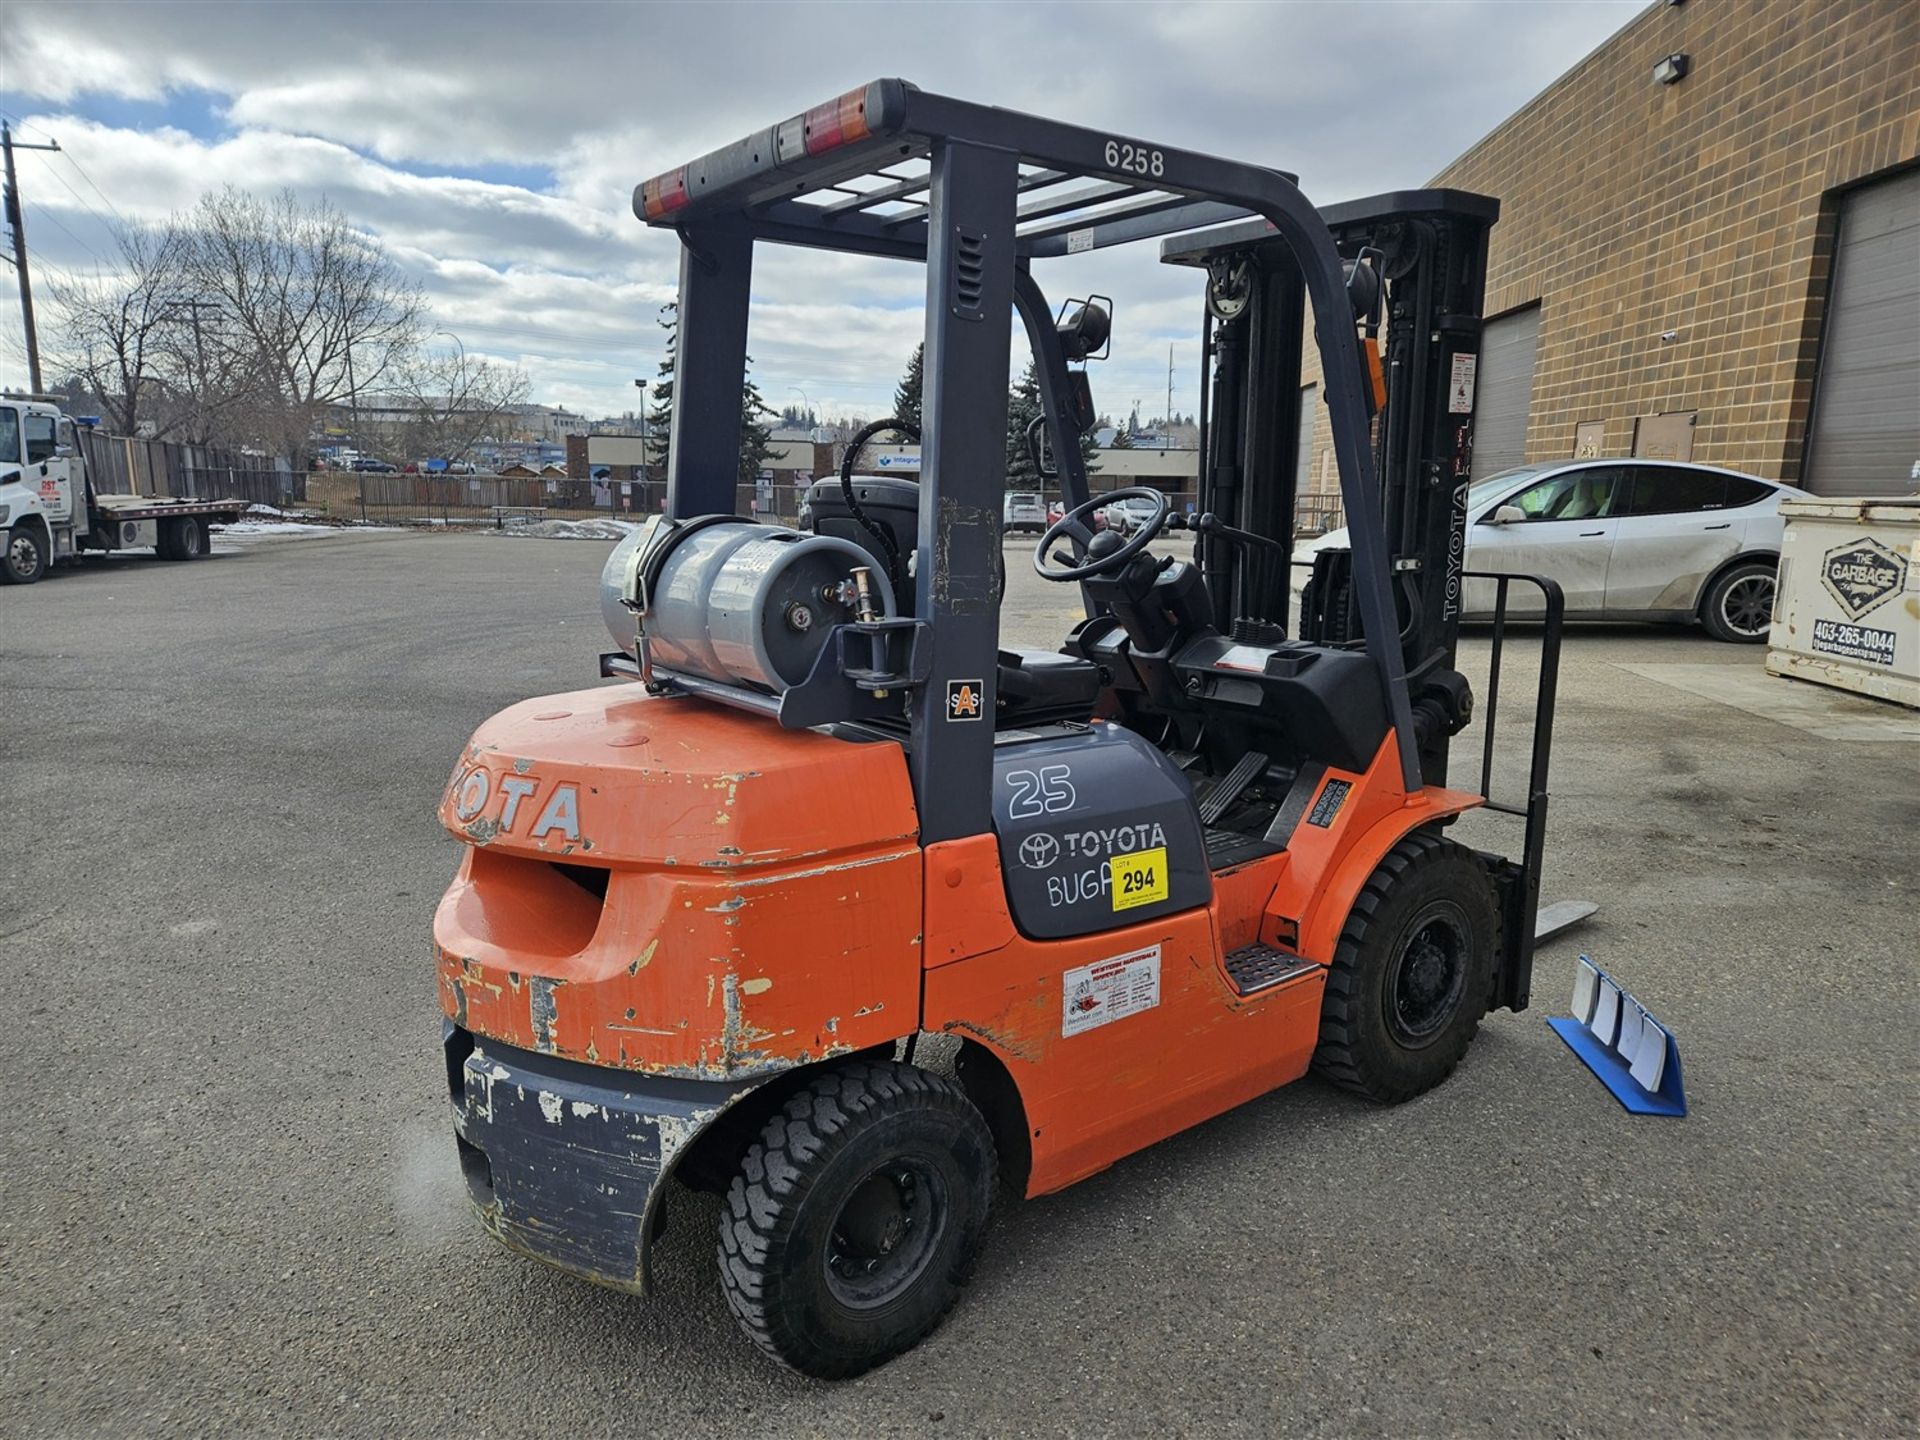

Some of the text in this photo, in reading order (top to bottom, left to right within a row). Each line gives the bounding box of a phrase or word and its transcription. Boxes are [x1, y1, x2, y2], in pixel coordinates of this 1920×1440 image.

[1105, 141, 1164, 176] 6258
[1444, 481, 1469, 621] TOYOTA
[1854, 553, 1875, 565] THE
[1831, 563, 1896, 588] GARBAGE
[1815, 621, 1895, 652] 403-265-0044
[453, 765, 581, 842] OTA
[1006, 764, 1076, 820] 25
[1064, 823, 1168, 857] TOYOTA
[1123, 867, 1155, 894] 294
